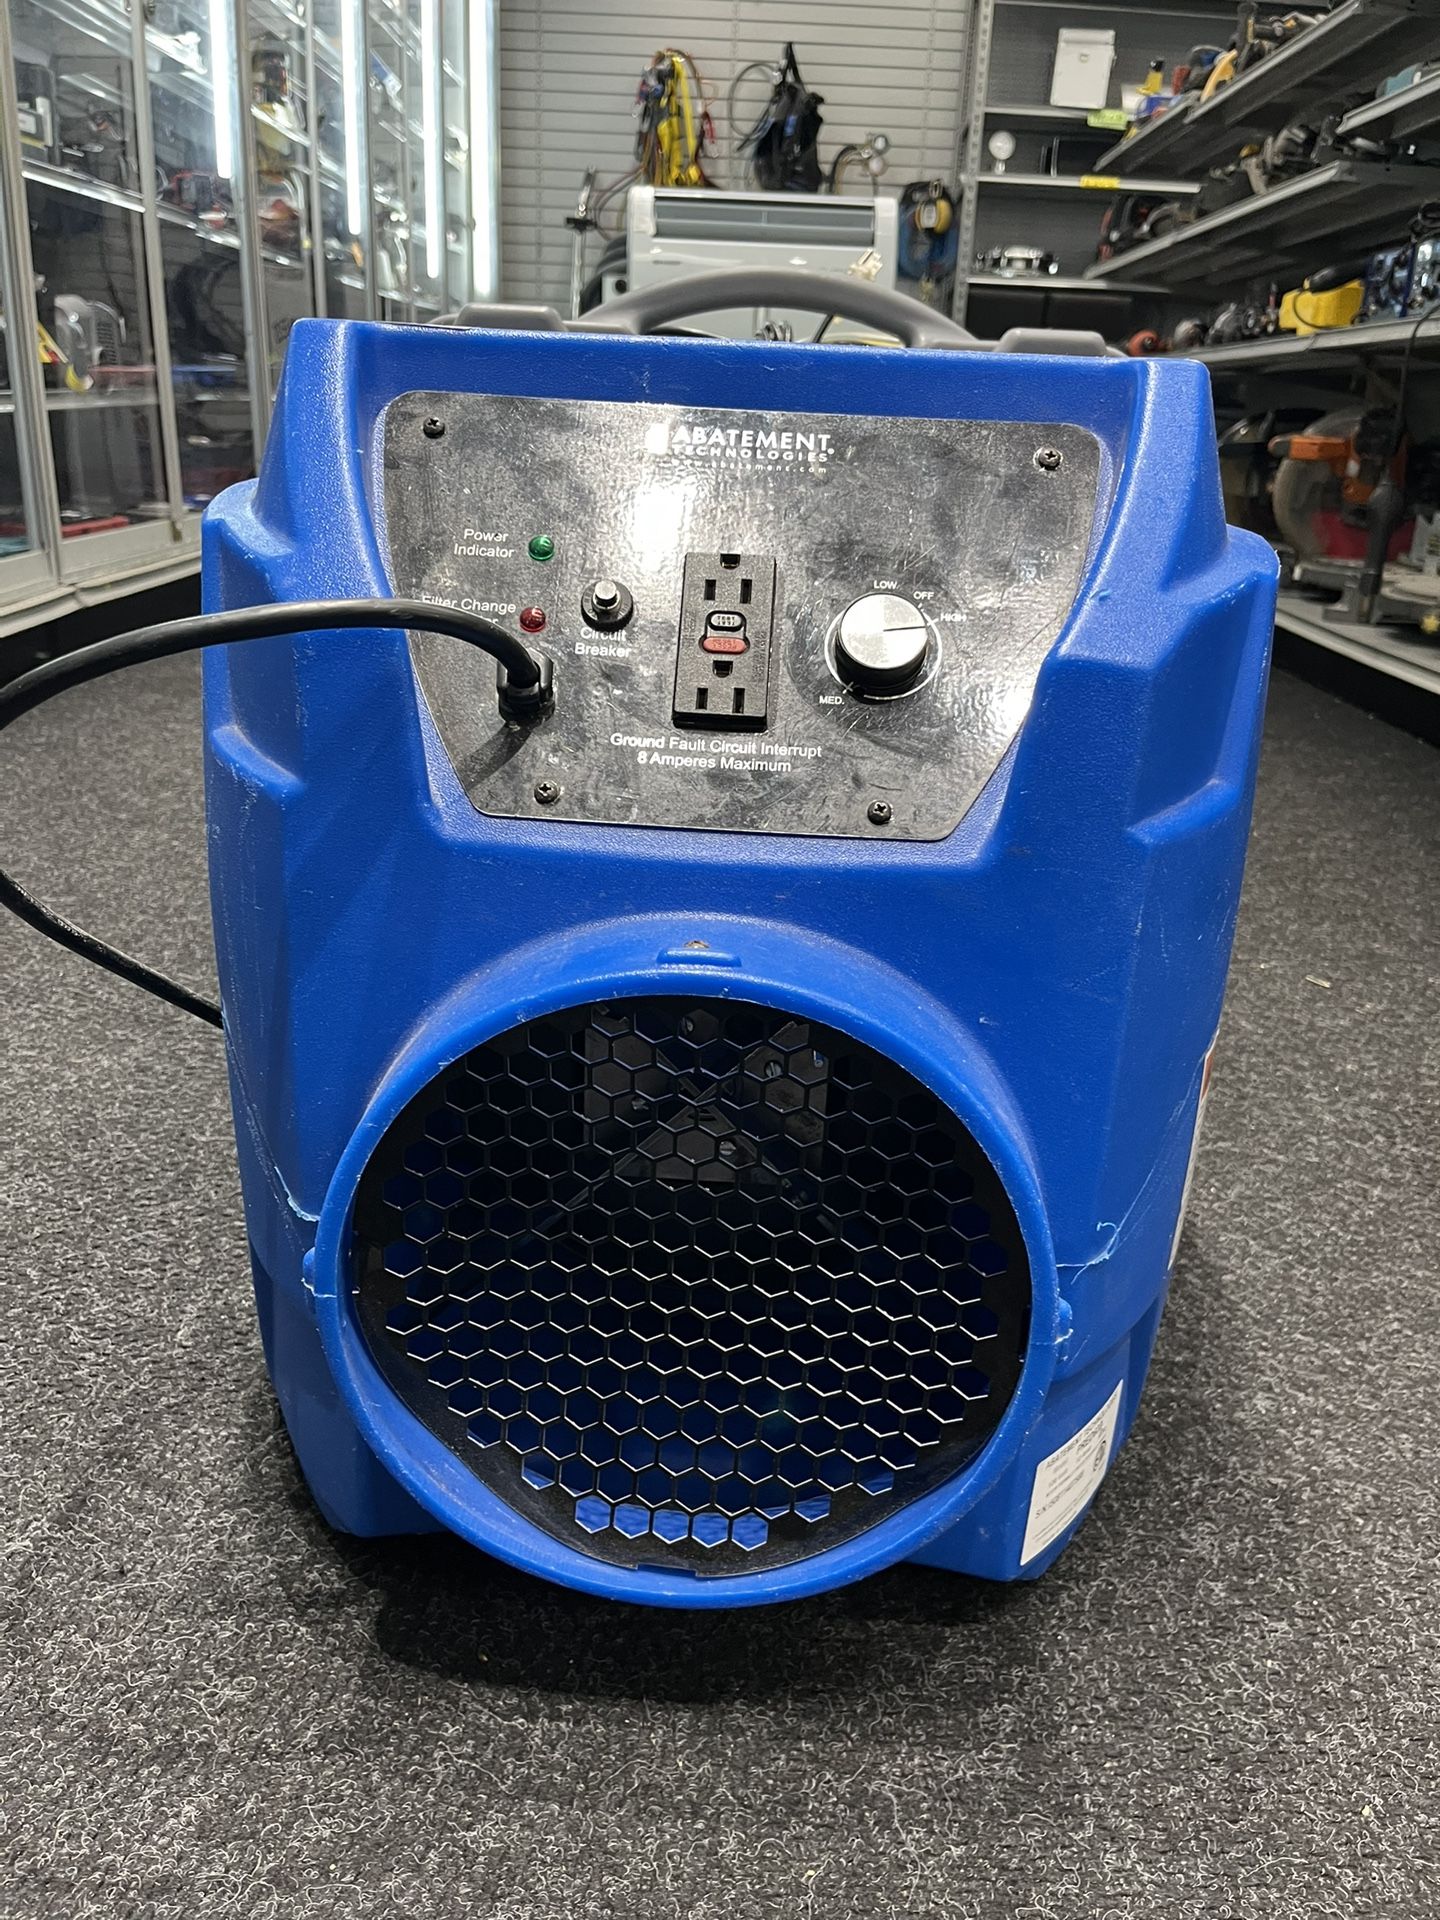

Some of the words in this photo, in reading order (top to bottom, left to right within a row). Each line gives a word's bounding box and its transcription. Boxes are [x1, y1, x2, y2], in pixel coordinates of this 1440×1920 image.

[671, 425, 832, 451] ABATEMENT
[673, 444, 829, 462] TECHNOLOGIES
[464, 528, 509, 543] Power
[454, 543, 514, 558] Indicator
[873, 580, 898, 590] LOW
[913, 591, 935, 600] OFF
[460, 598, 517, 615] Change
[940, 612, 967, 622] HIGH
[580, 627, 627, 642] Circuit
[574, 642, 632, 658] Breaker
[819, 695, 845, 705] MED.
[610, 732, 665, 748] Ground
[669, 737, 706, 751] Fault
[710, 740, 757, 755] Circuit
[761, 742, 822, 758] Interrupt
[637, 751, 647, 764] 8
[649, 752, 716, 769] Amperes
[720, 756, 792, 772] Maximum
